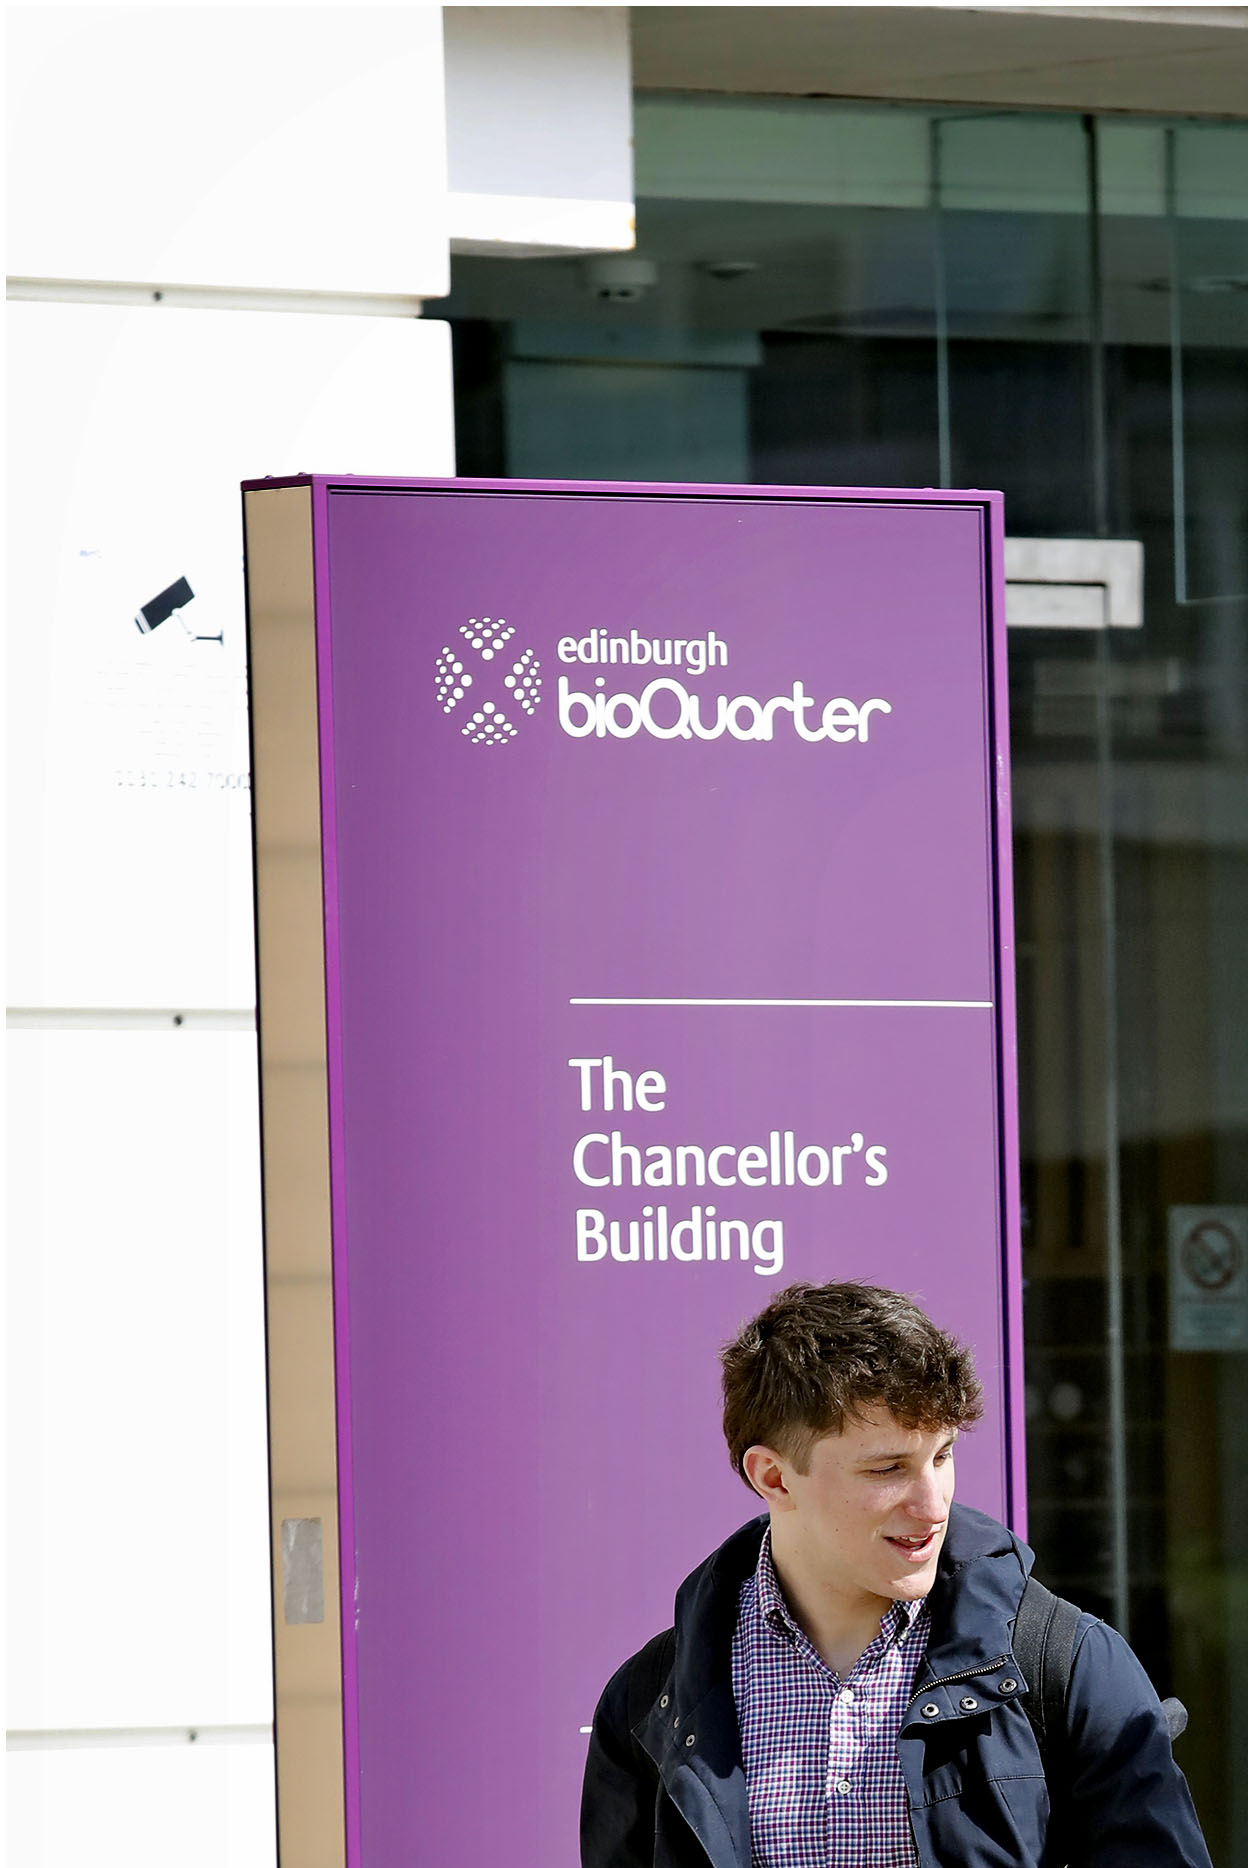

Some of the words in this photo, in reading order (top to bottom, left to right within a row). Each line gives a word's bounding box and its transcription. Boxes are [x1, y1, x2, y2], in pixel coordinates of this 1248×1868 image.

[557, 628, 728, 674] edinburgh
[558, 676, 892, 742] bioQuarter
[568, 1055, 667, 1112] The
[572, 1130, 889, 1188] Chancellor's
[575, 1204, 785, 1277] Building
